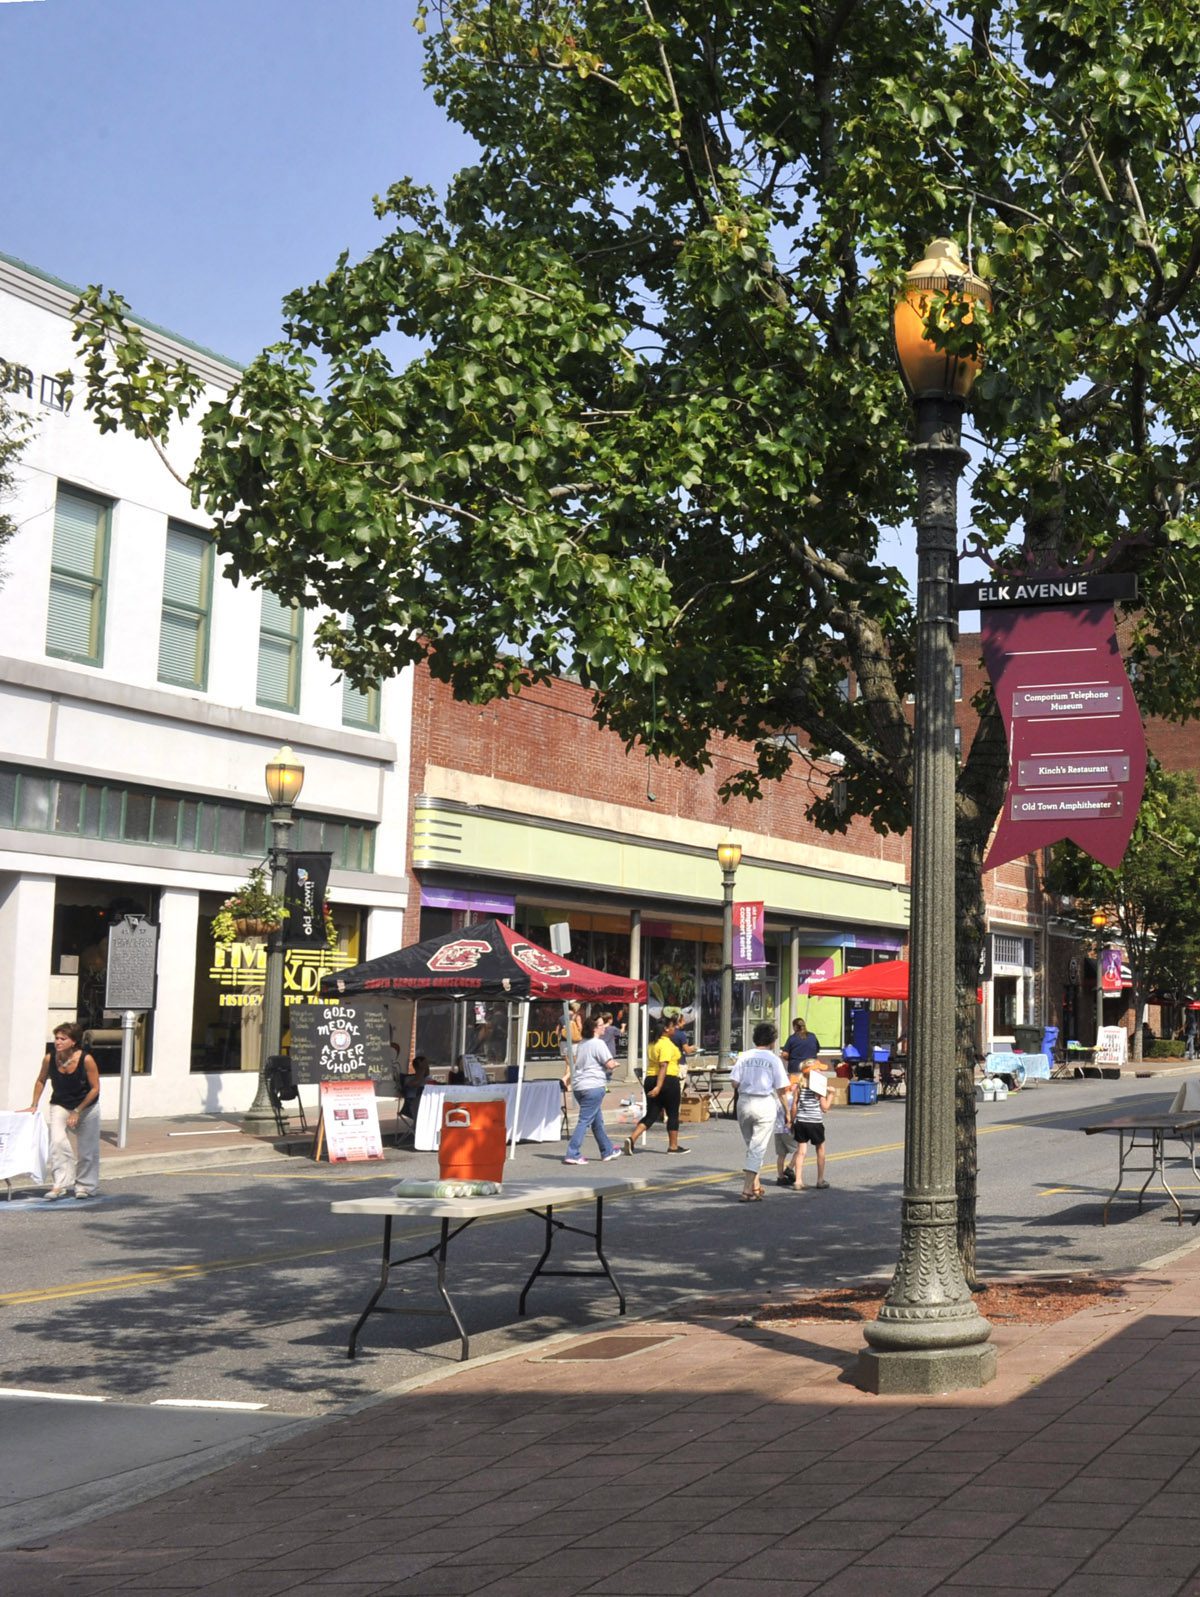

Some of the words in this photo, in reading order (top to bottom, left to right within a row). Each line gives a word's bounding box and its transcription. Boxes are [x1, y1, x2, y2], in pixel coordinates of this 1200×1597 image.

[978, 585, 1010, 601] ELK
[1014, 581, 1088, 599] AVENUE
[1024, 693, 1068, 702] Comporium
[1069, 690, 1109, 699] Telephone
[1050, 702, 1083, 711] Museum
[1038, 766, 1066, 775] Kinch's
[1067, 765, 1108, 774] Restaurant
[1021, 802, 1036, 810] Old
[1036, 802, 1058, 810] Town
[1059, 800, 1112, 811] Amphitheater
[302, 916, 313, 935] old
[745, 906, 753, 961] amphitheater
[219, 994, 264, 1006] HISTORY
[323, 1006, 356, 1020] GOLD
[317, 1019, 360, 1036] MEDAL
[321, 1043, 365, 1061] AFTER
[319, 1055, 367, 1074] SCHOOL
